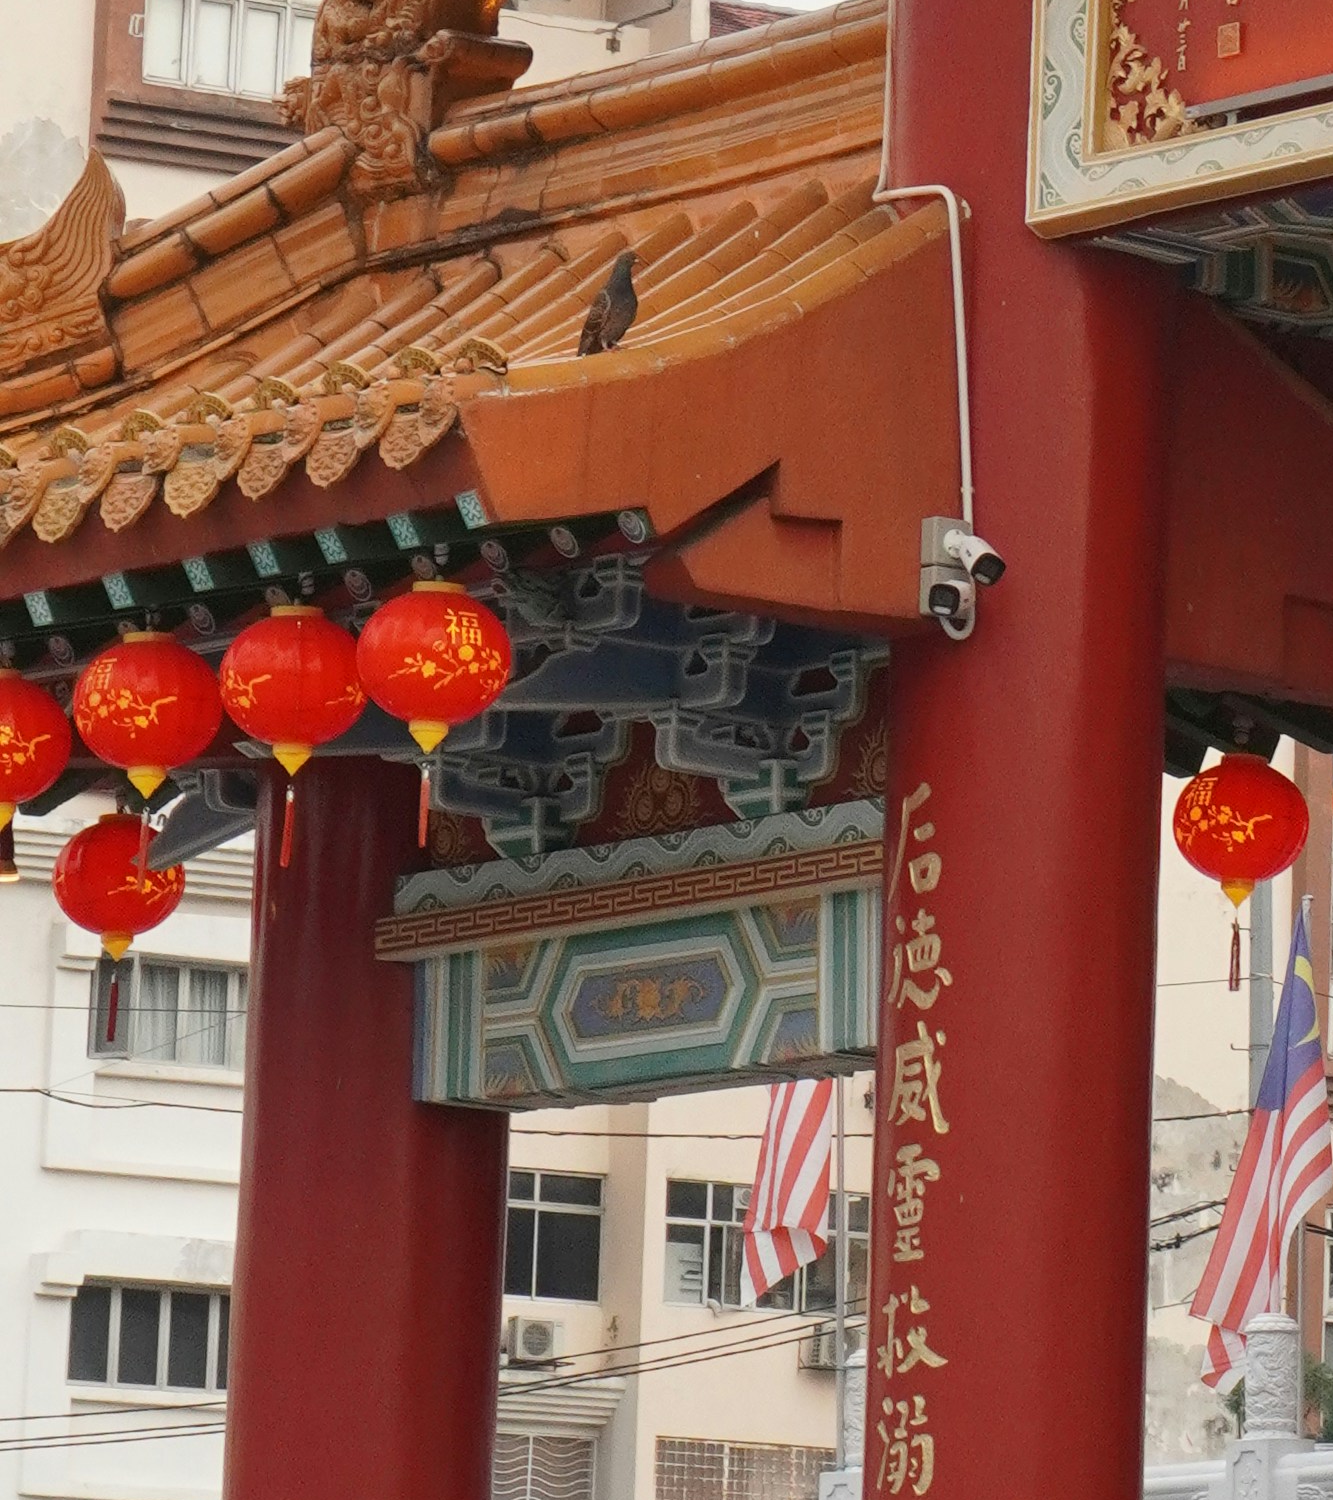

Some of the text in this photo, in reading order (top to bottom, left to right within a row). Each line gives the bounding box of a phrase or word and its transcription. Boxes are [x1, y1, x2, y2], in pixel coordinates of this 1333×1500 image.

[444, 608, 482, 647] 福
[85, 658, 118, 694] 福
[1185, 777, 1218, 809] 福
